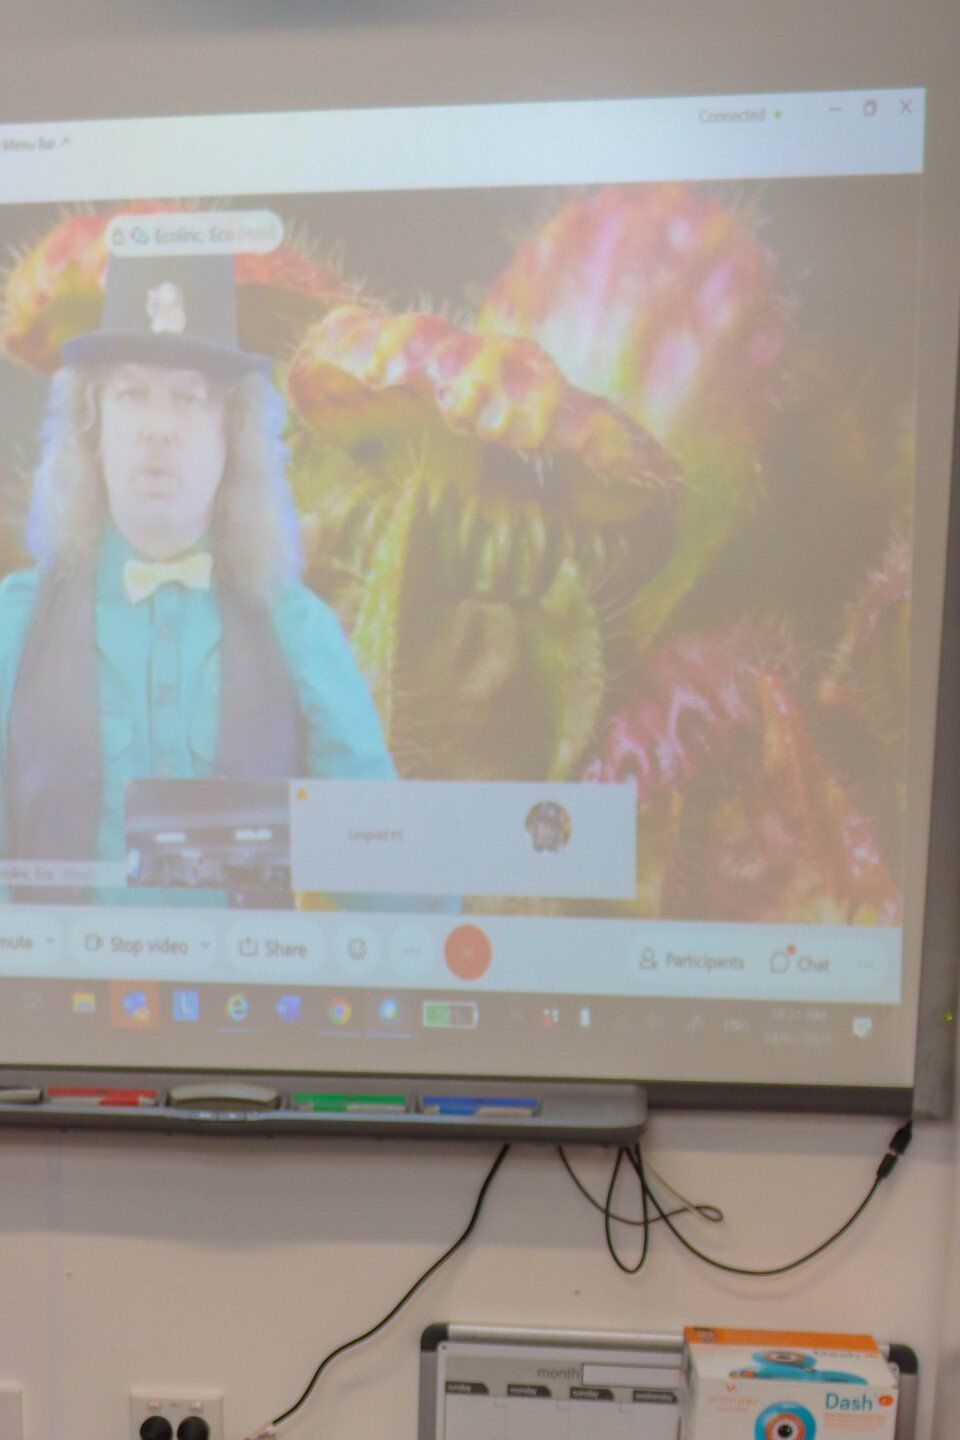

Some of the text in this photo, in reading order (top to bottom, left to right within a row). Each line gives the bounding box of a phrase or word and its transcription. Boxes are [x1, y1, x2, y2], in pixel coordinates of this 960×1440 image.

[110, 934, 189, 957] Stop video
[265, 939, 309, 959] Share
[666, 952, 747, 973] Participants
[797, 955, 830, 973] Chat
[537, 1367, 580, 1380] month
[825, 1392, 873, 1411] Dash
